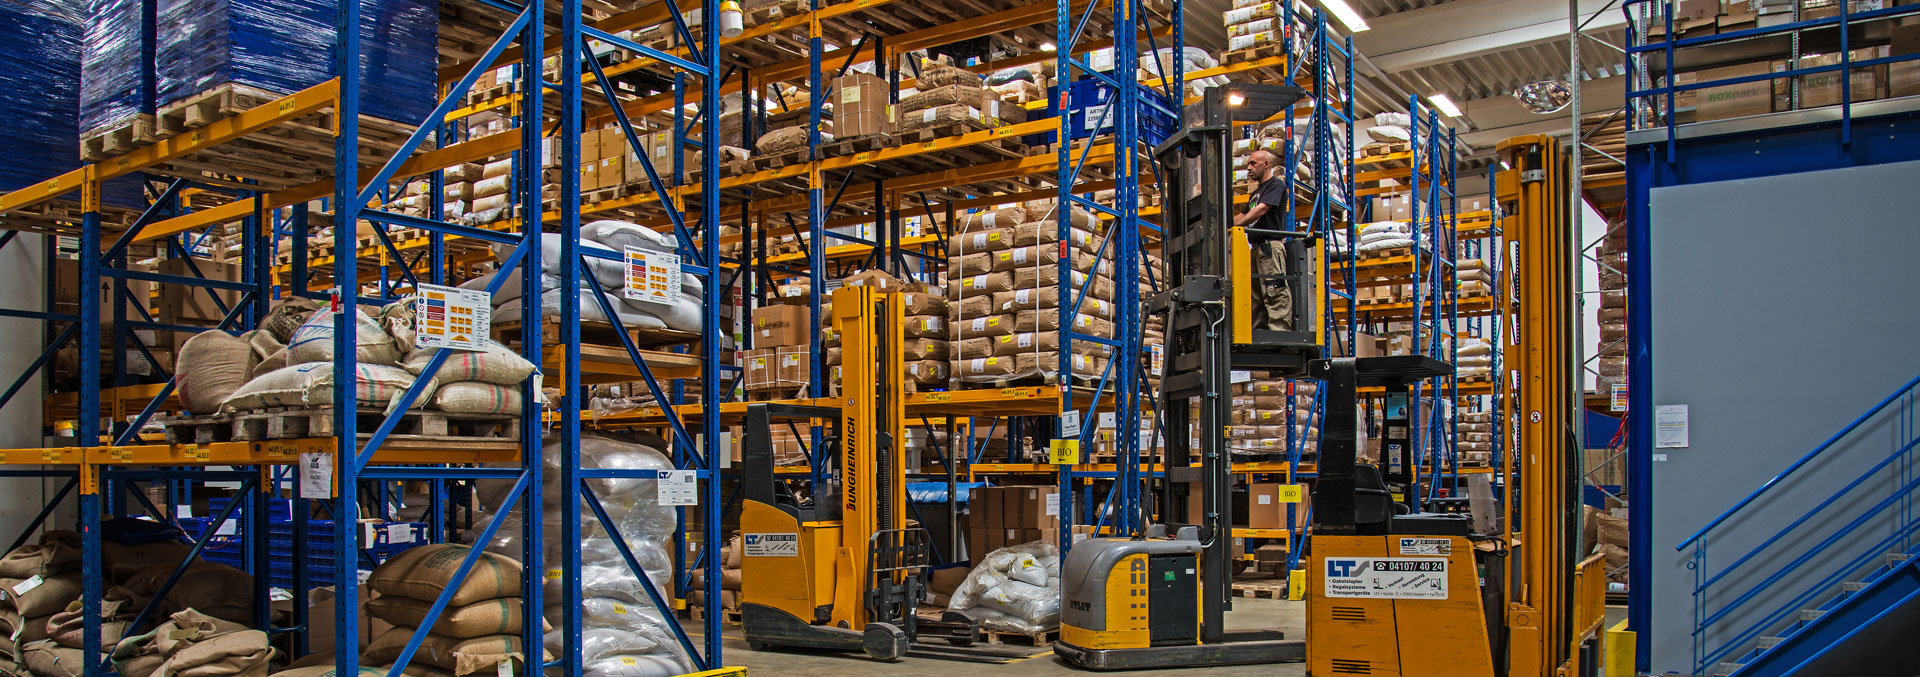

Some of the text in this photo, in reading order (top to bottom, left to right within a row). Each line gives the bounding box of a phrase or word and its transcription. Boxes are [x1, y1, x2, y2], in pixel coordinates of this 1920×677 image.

[1709, 87, 1759, 102] BOXpack
[1057, 448, 1072, 457] BIO
[847, 416, 857, 512] JUNGHEINRICH
[1389, 562, 1443, 571] 04107/ 40 24
[1388, 577, 1404, 588] Verkauf
[1401, 574, 1425, 588] Vermietung
[1414, 577, 1430, 588] Service
